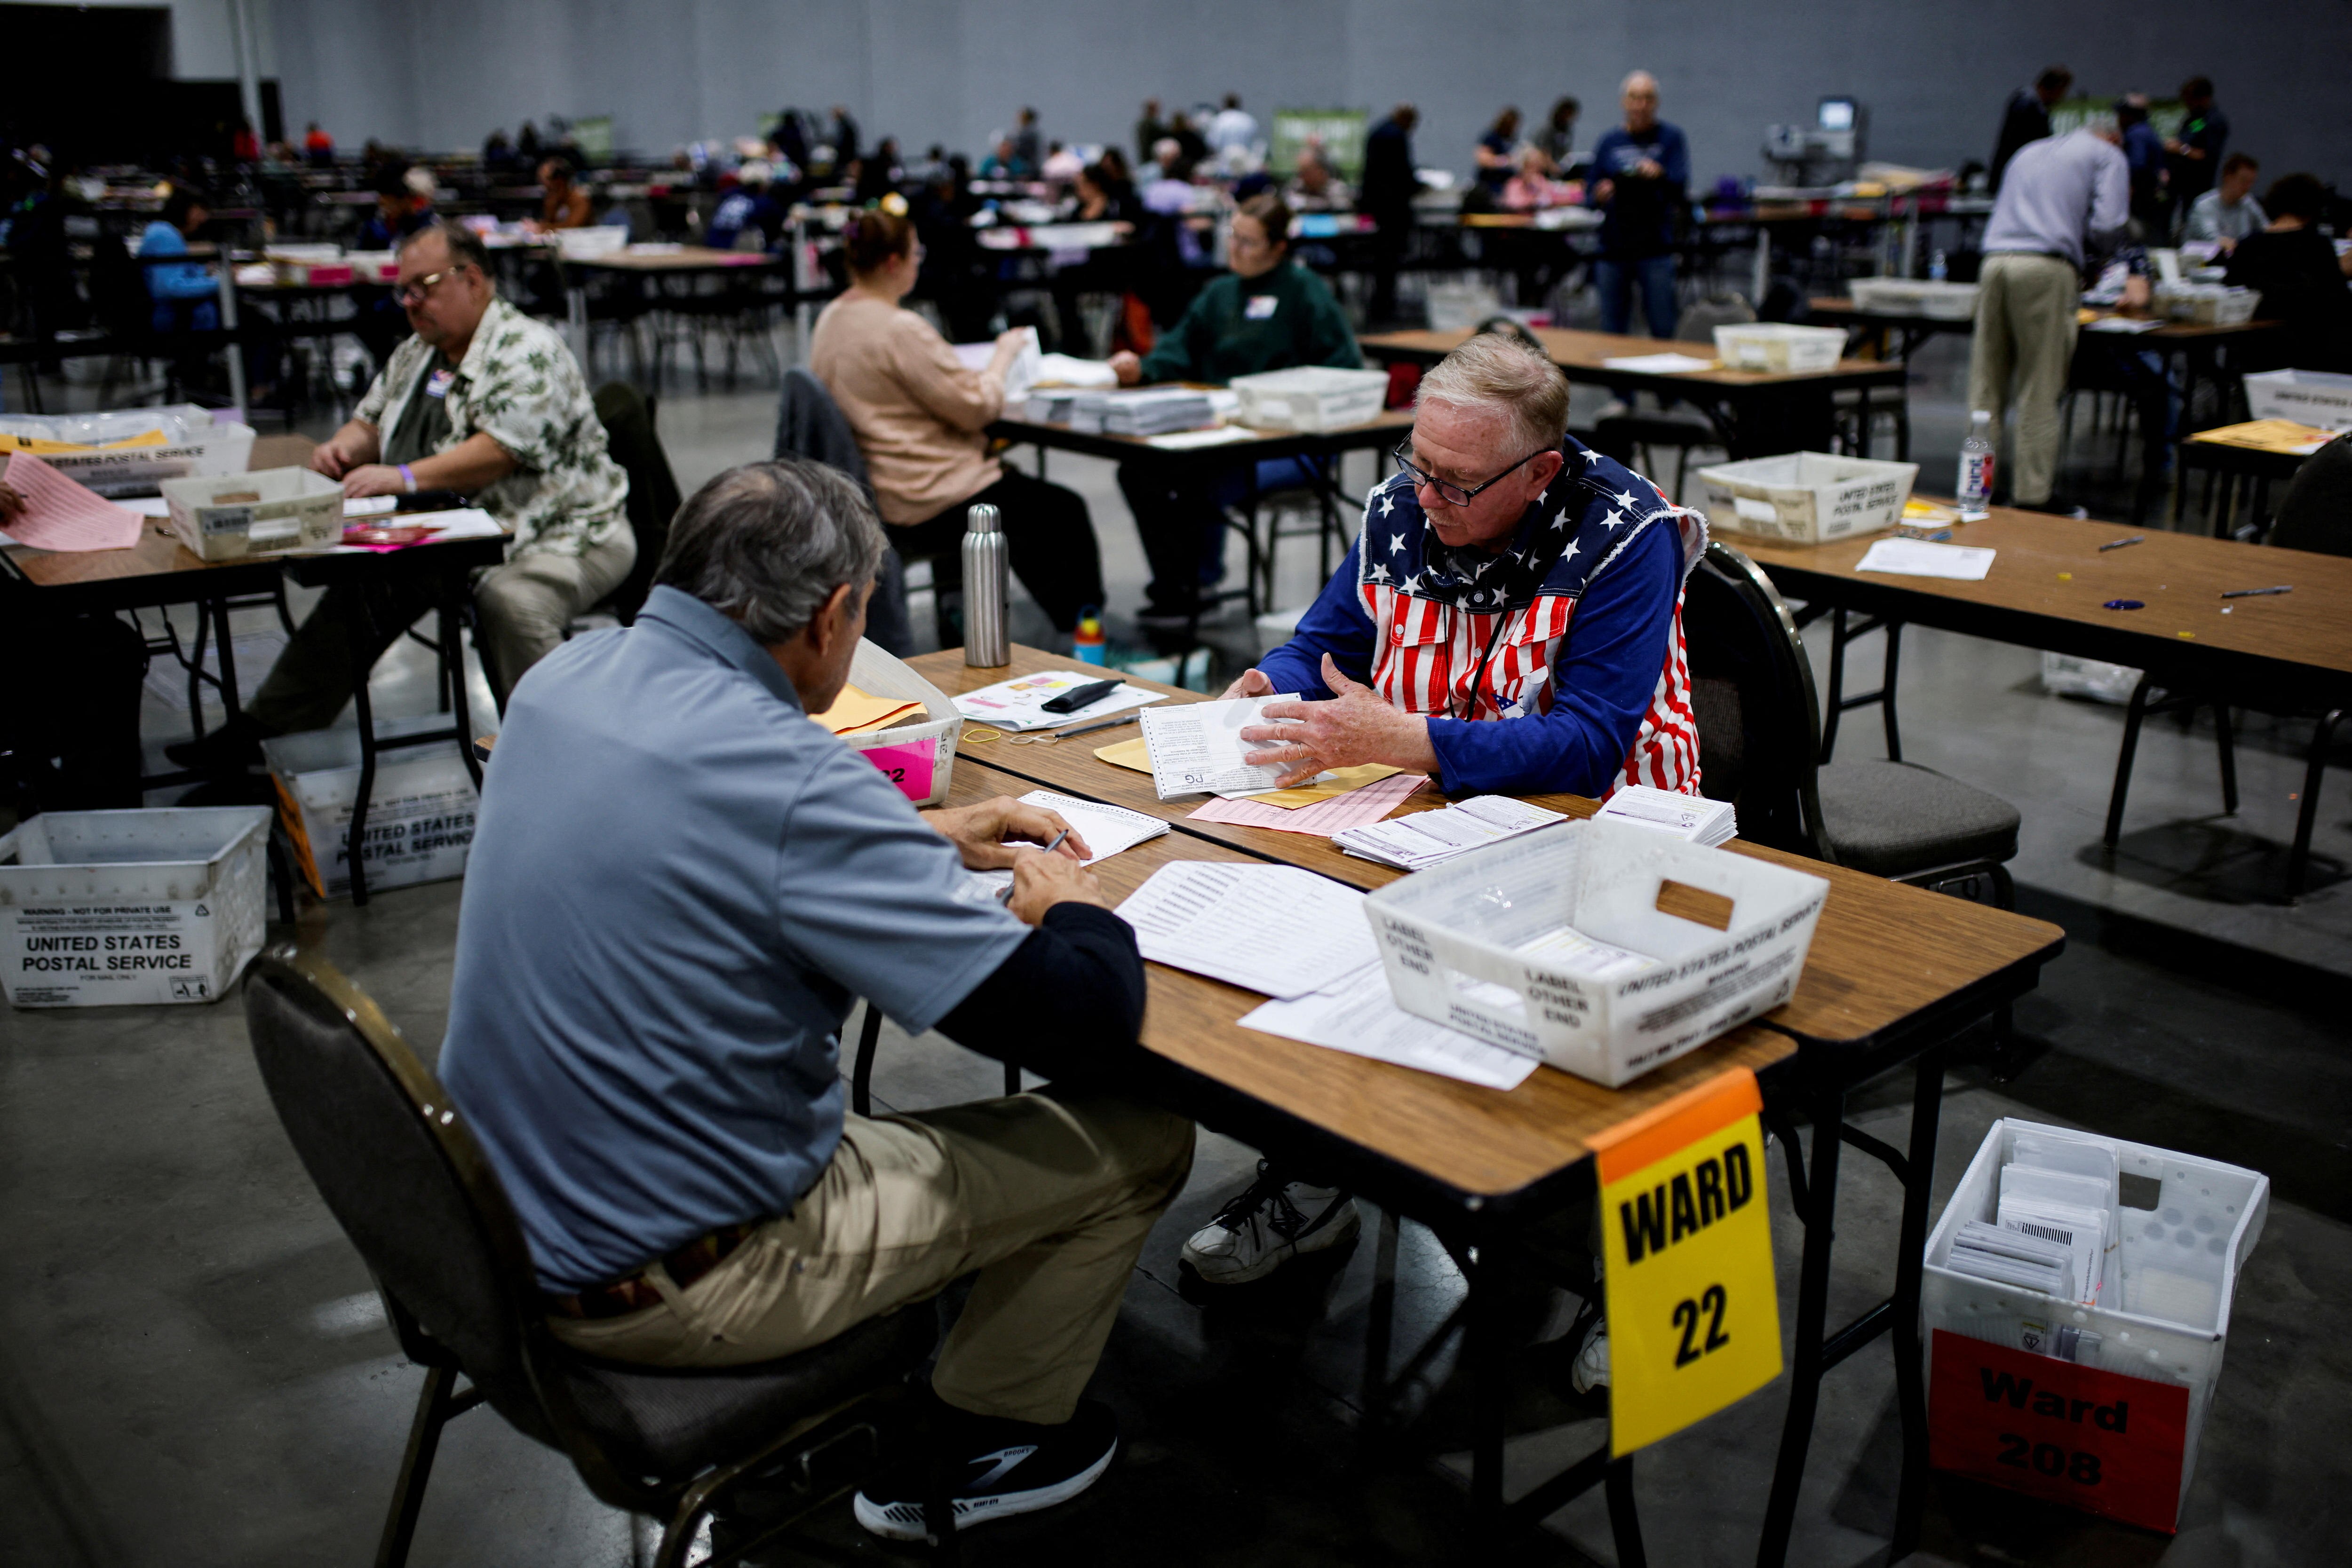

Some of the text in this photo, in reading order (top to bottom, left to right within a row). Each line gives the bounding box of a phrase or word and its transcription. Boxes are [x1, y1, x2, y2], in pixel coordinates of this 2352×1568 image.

[105, 451, 151, 464] POSTAL
[155, 445, 205, 461] SERVICE
[1833, 492, 1898, 516] POSTAL SERVICE
[1839, 480, 1896, 502] UNITED STATES
[1184, 774, 1203, 784] PG
[342, 812, 475, 845] UITED STATES
[337, 841, 406, 864] PSTAL
[411, 829, 473, 853] SERVIC
[27, 935, 180, 951] UNITED STATES
[1383, 918, 1426, 944] LABEL
[1386, 933, 1435, 963] OTHER
[23, 954, 191, 971] POSTAL SERVICE
[1399, 954, 1430, 976] END
[1619, 969, 1677, 998] UNITED
[1679, 949, 1731, 979] STATES
[1733, 927, 1777, 954] POSTAL
[1524, 967, 1582, 995] LABEL
[1449, 1003, 1490, 1023] UNITED
[1527, 987, 1589, 1013] OTHER
[1543, 1008, 1581, 1029] END
[1620, 1142, 1753, 1266] WARD
[1672, 1283, 1730, 1370] 22
[1980, 1367, 2129, 1435] Ward
[1004, 1448, 1029, 1457] BROOKS
[1997, 1433, 2103, 1486] 208
